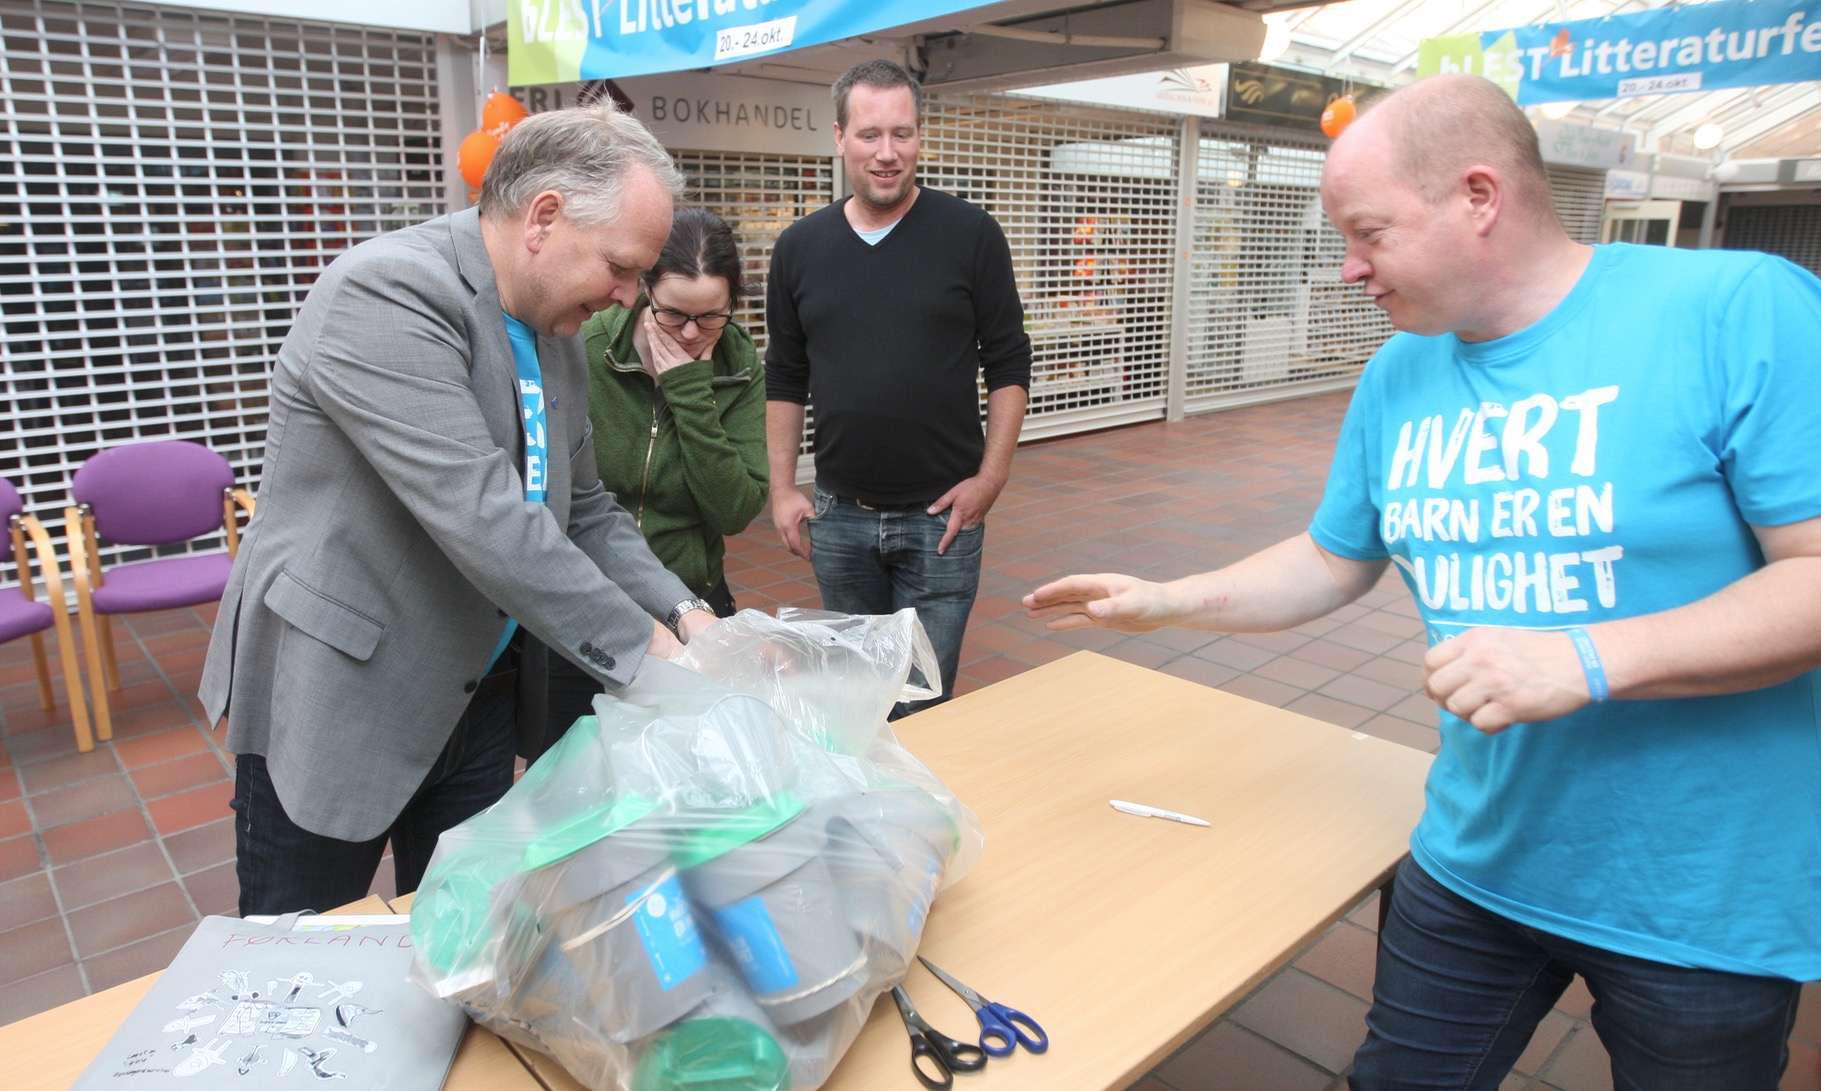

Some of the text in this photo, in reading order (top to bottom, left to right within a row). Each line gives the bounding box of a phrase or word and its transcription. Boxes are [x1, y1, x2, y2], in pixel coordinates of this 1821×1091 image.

[652, 96, 817, 131] BOKHANDEL
[1388, 386, 1619, 490] HVERT
[1384, 482, 1613, 544] BARN ER EN
